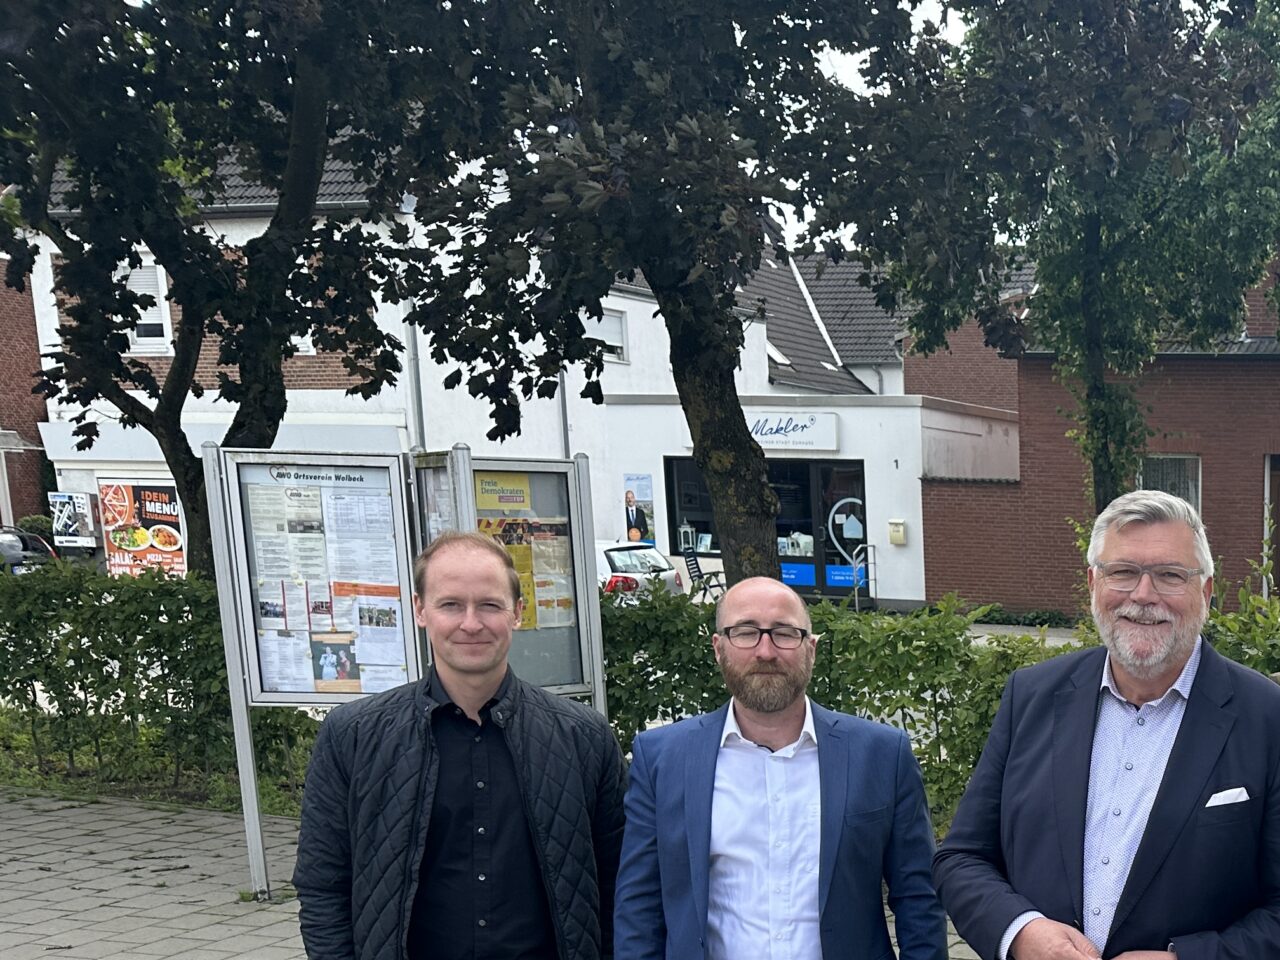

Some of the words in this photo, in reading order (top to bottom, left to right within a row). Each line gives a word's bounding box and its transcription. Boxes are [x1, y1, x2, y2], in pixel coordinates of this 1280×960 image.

[750, 416, 809, 437] Makler
[293, 472, 332, 481] Ortsverein
[335, 474, 364, 482] Wolbeck
[145, 490, 169, 503] DEIN
[481, 487, 525, 495] Demokraten
[145, 500, 179, 516] MENÜ
